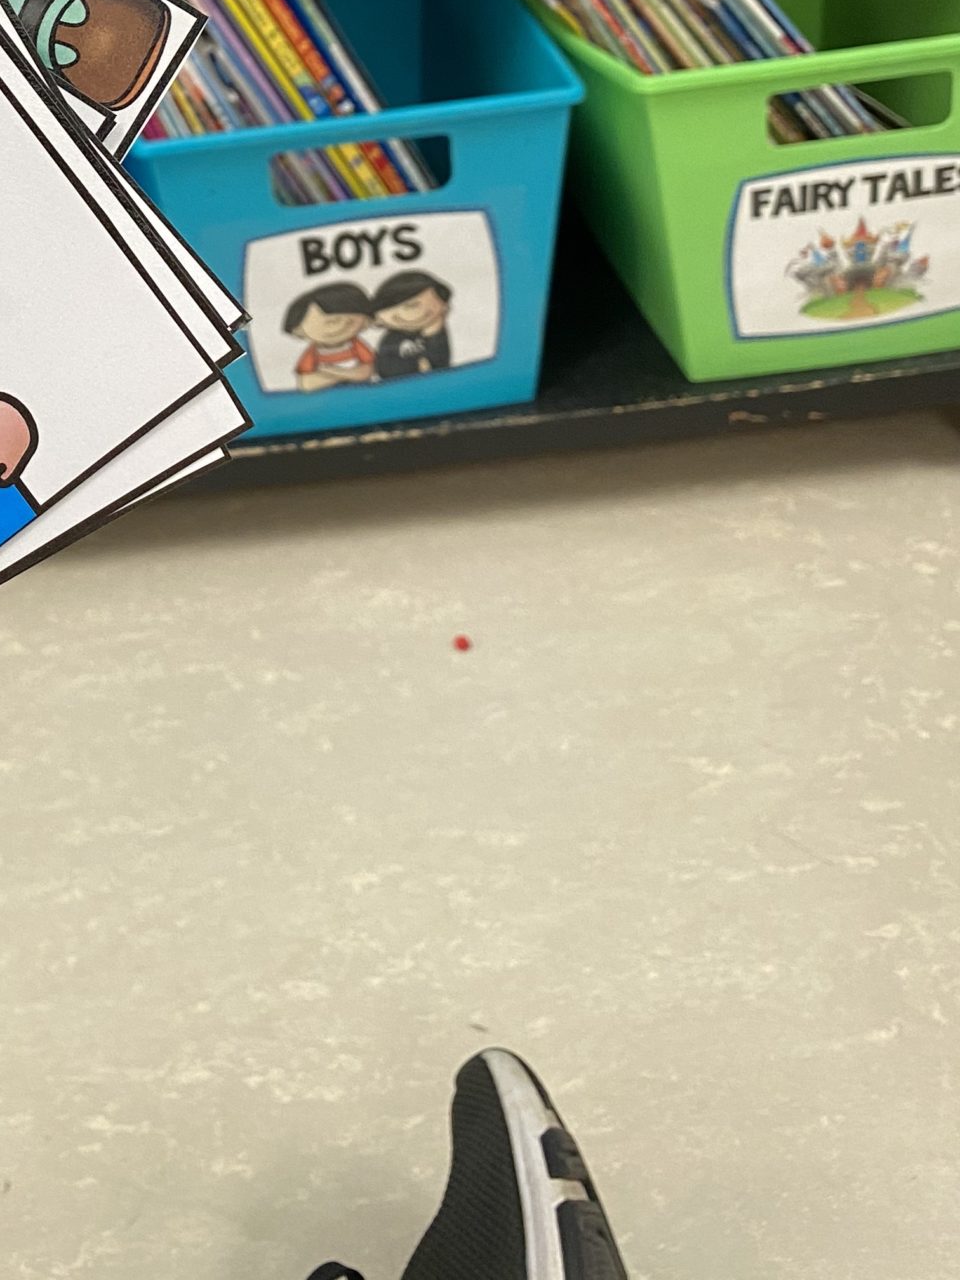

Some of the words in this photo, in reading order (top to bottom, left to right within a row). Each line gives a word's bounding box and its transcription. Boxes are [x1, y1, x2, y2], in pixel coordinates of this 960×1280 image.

[750, 176, 856, 218] FAIRY
[861, 165, 960, 206] TALE
[300, 223, 423, 277] BOYS
